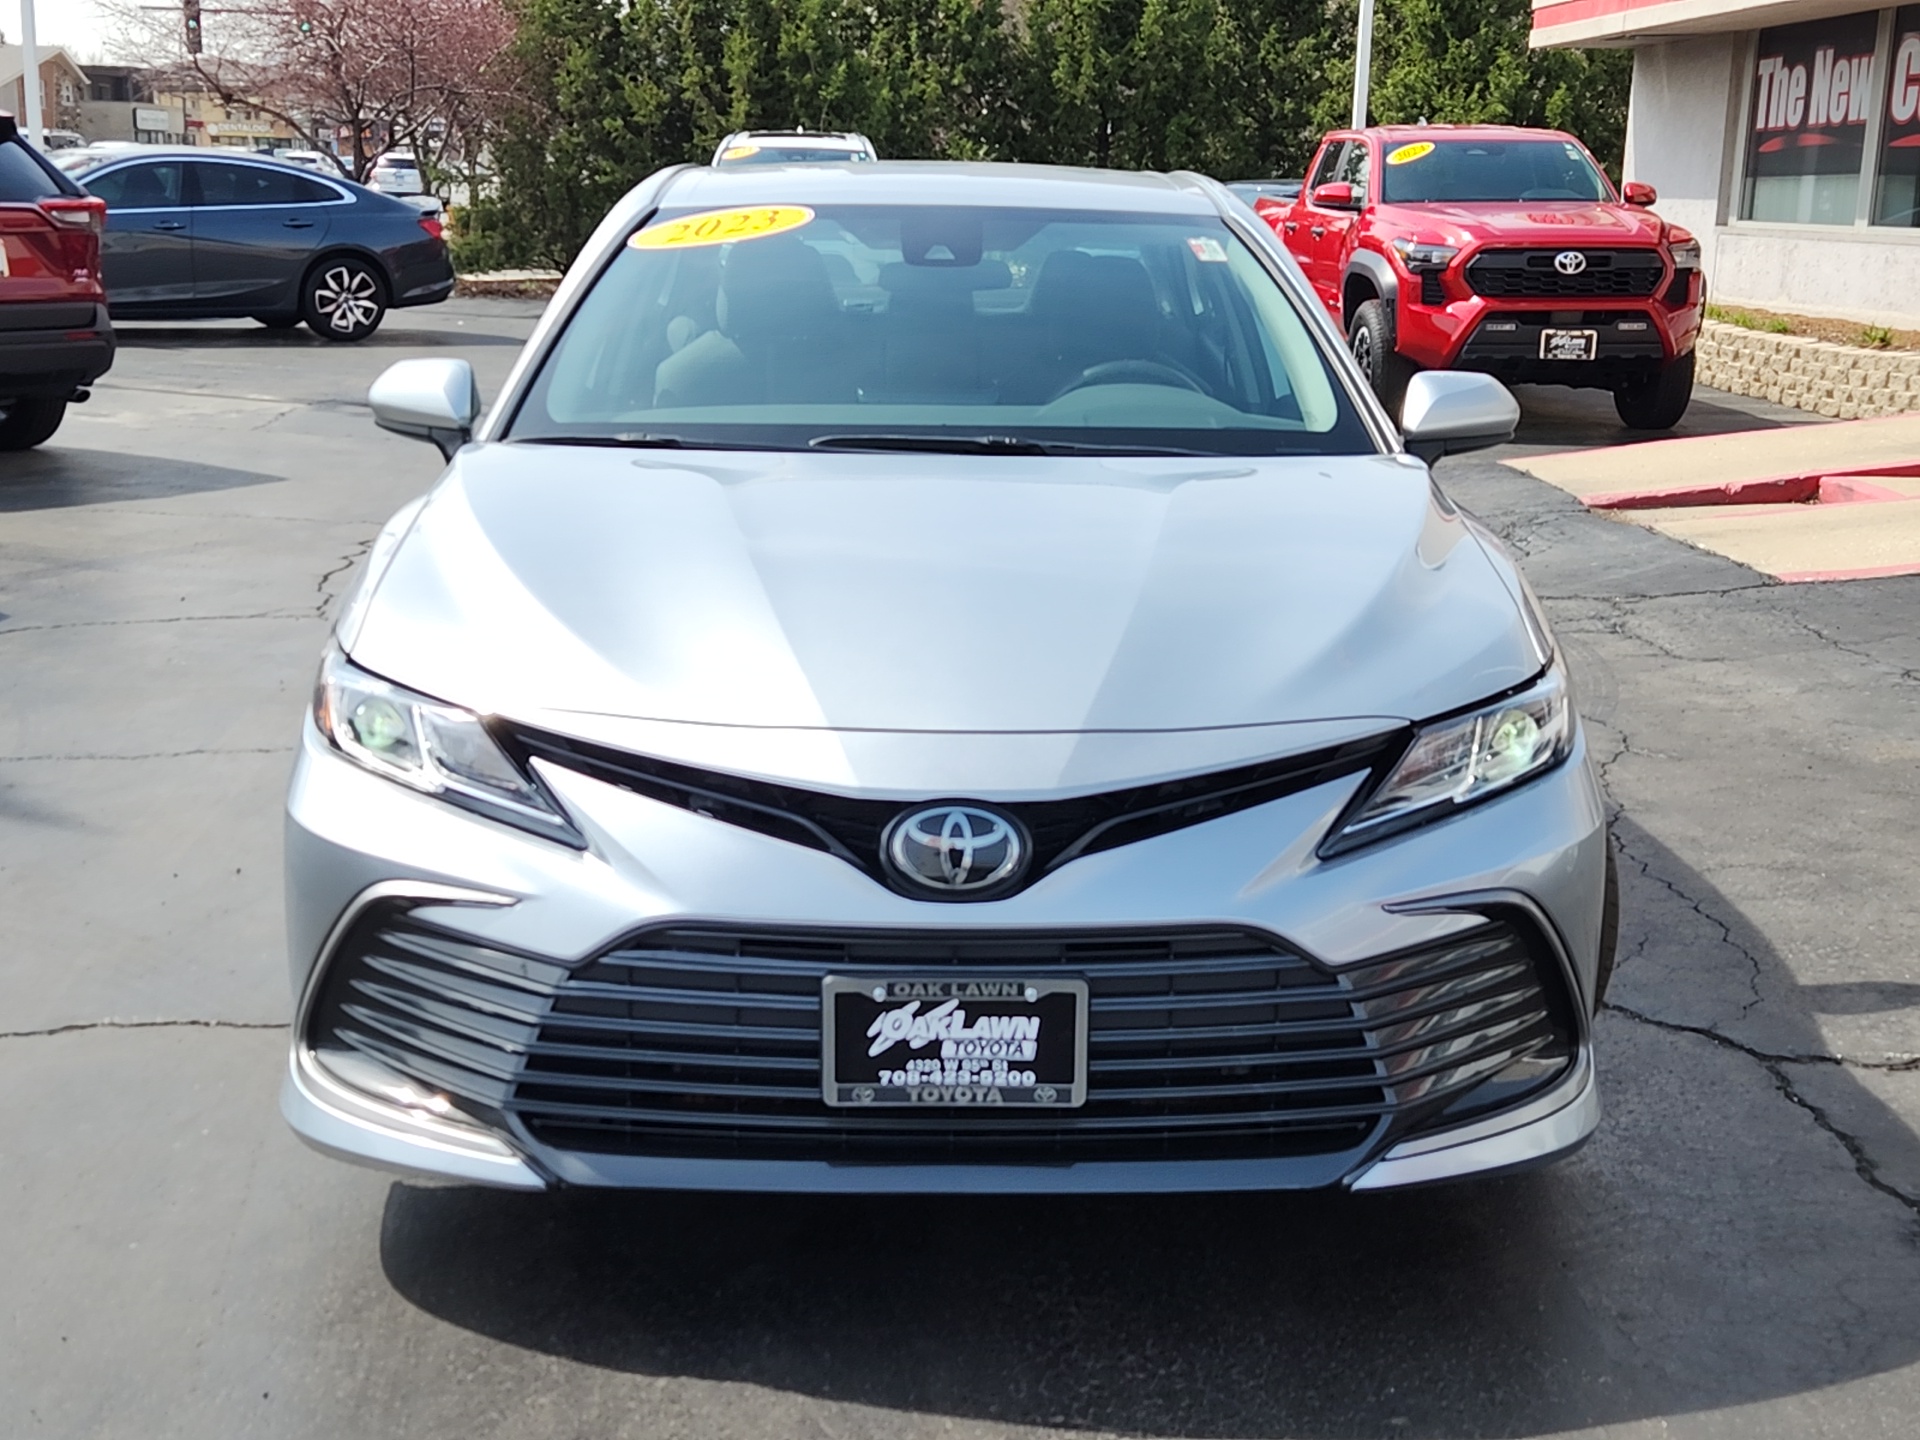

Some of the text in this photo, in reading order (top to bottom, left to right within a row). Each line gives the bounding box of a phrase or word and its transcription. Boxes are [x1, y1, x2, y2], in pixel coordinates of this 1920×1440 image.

[1755, 36, 1920, 131] The New C
[664, 209, 780, 243] 2023
[893, 982, 1019, 997] OAK LAWN
[954, 1040, 1025, 1057] TOYOTA
[943, 1059, 959, 1072] W
[906, 1086, 1004, 1103] TOYOTA
